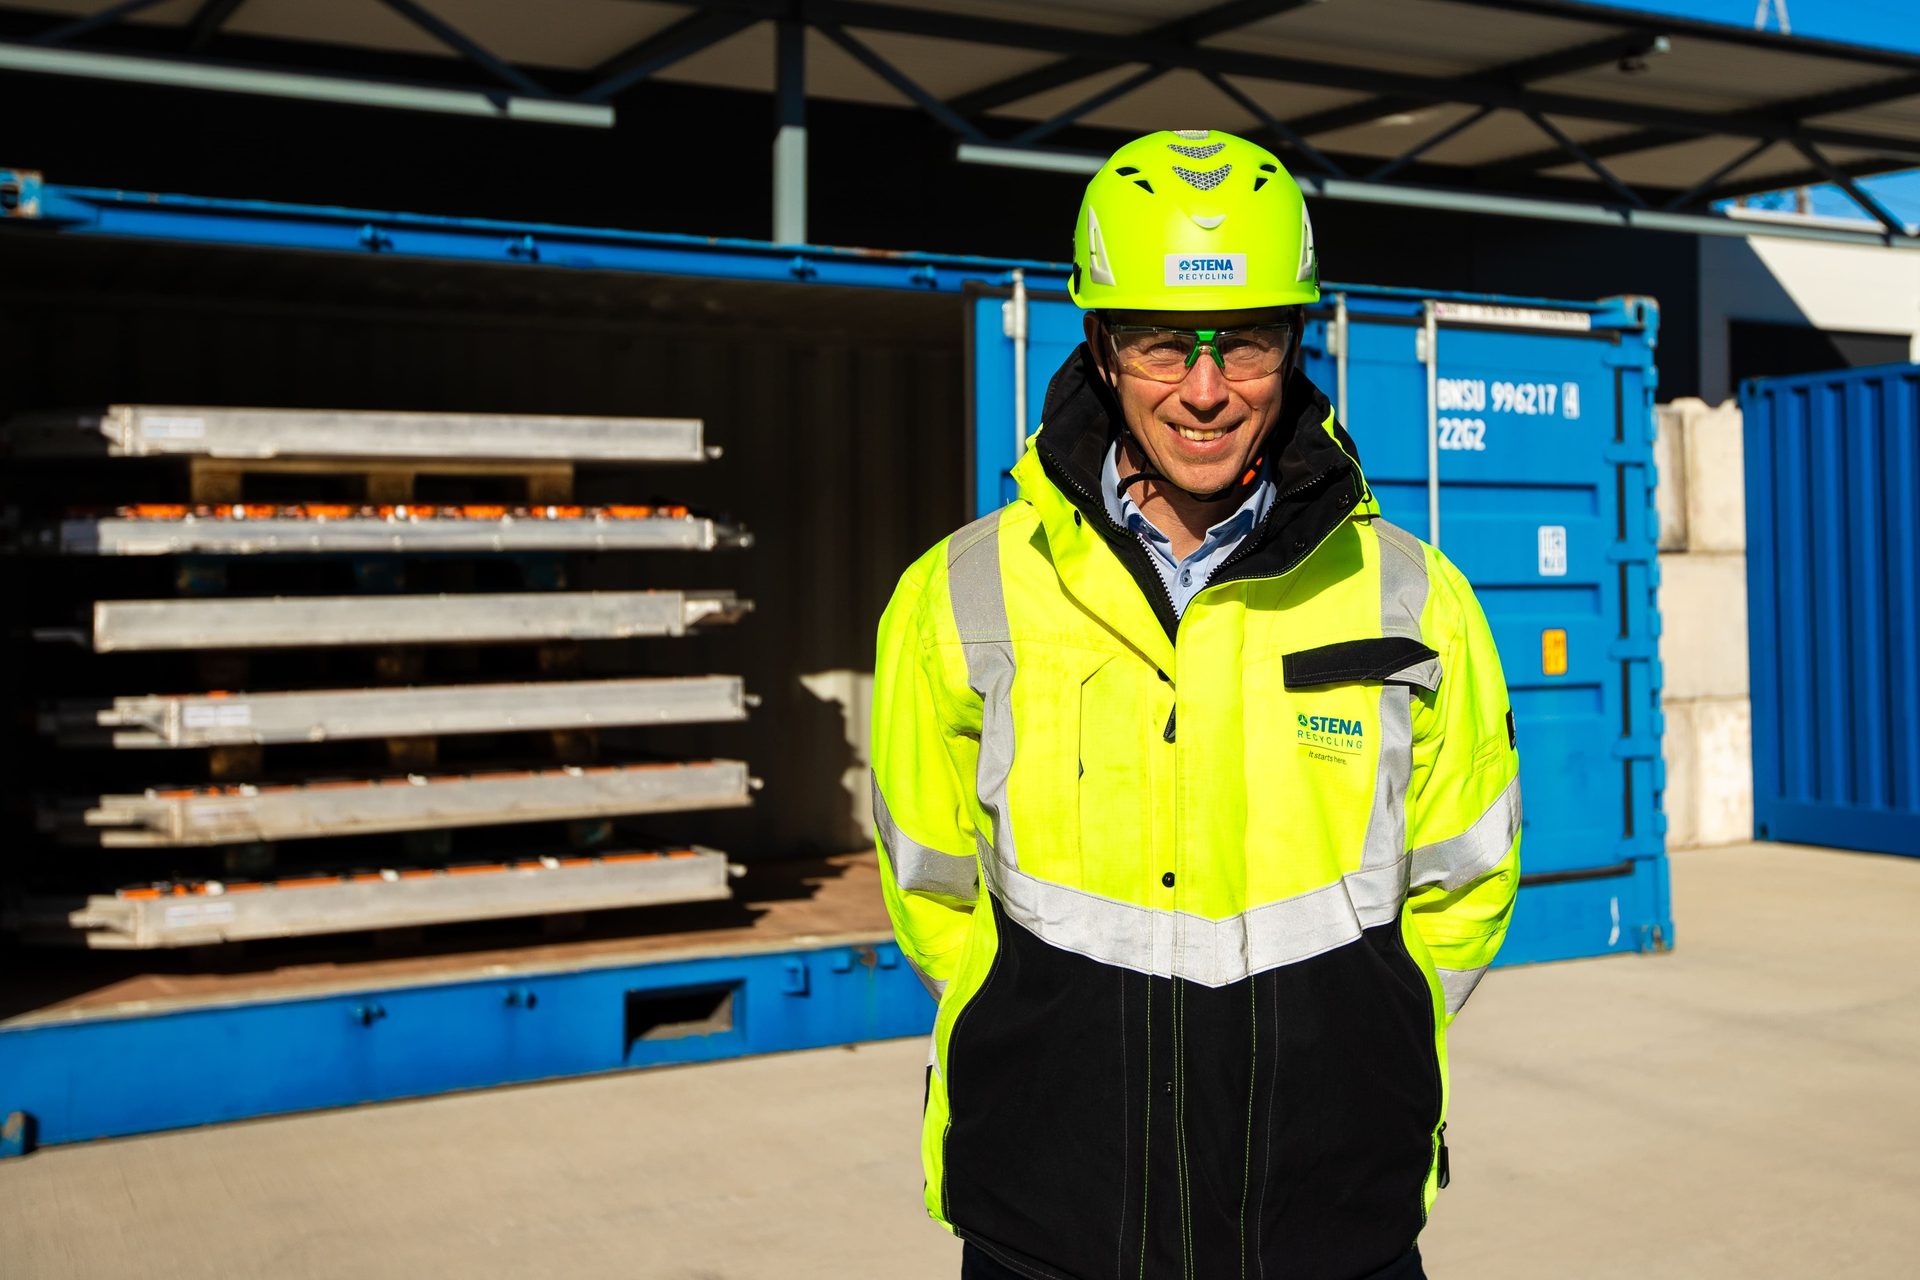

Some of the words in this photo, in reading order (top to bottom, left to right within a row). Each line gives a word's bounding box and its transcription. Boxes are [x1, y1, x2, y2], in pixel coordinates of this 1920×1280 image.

[1191, 259, 1233, 271] STENA
[1437, 378, 1486, 412] BNSU
[1491, 381, 1558, 416] 996217
[1438, 417, 1486, 451] 22G2
[1309, 716, 1363, 736] STENA
[1297, 730, 1363, 749] RECYCLING
[1308, 750, 1314, 758] It
[1314, 752, 1333, 762] starts
